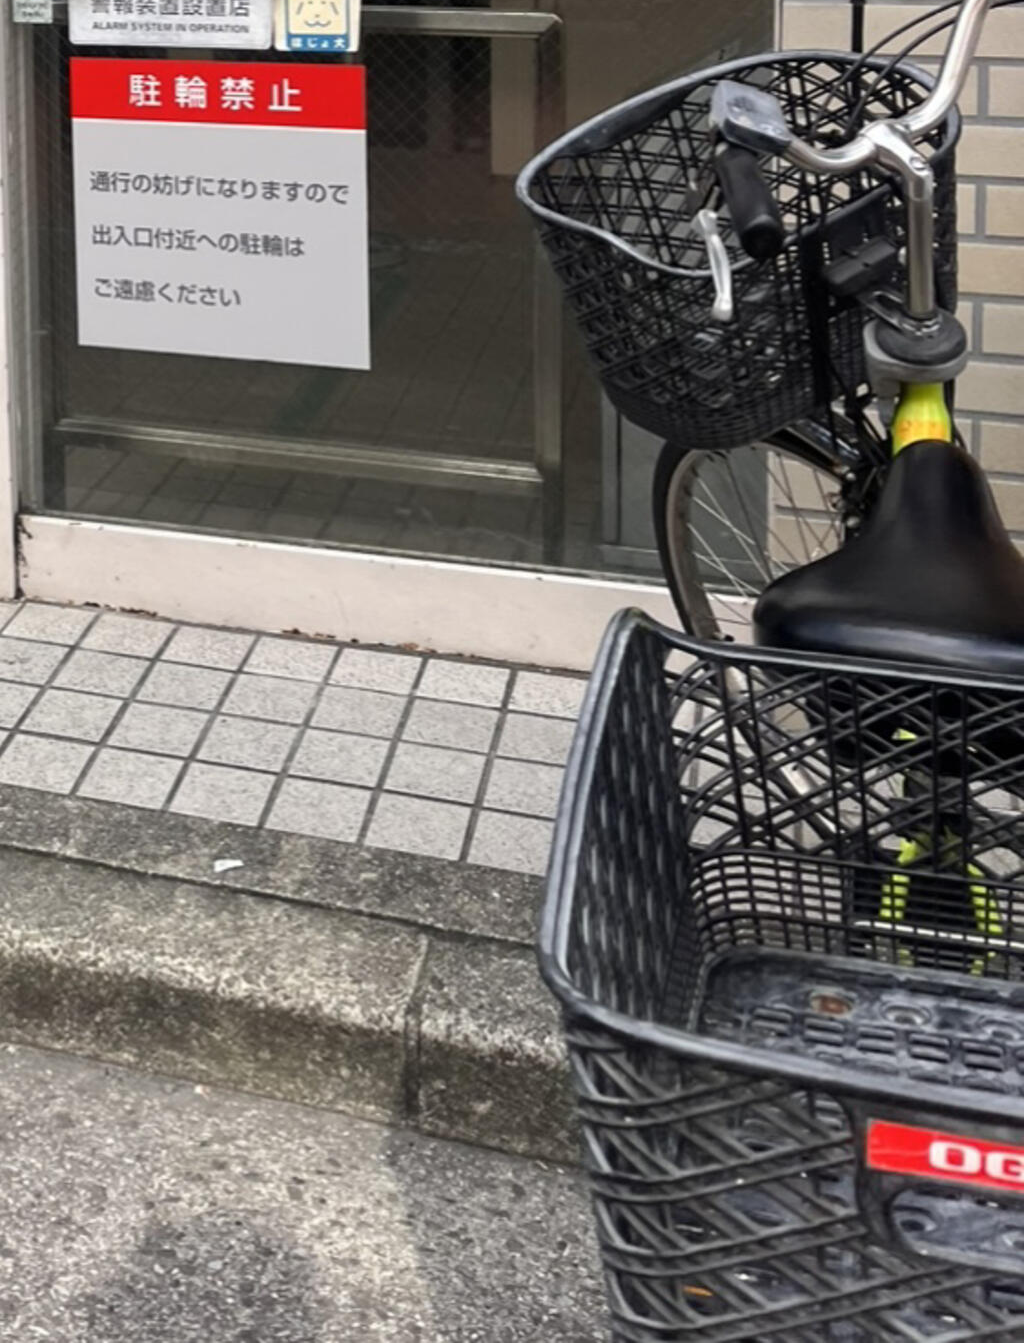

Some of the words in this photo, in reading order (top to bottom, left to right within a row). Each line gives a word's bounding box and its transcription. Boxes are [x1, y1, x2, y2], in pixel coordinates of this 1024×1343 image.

[92, 21, 128, 30] ALARM
[131, 22, 172, 32] SYSTEM
[175, 23, 186, 32] IN
[188, 23, 249, 33] OPERATION
[129, 74, 302, 112] 駐輪禁止
[90, 170, 349, 205] 通行の妨げになりますので
[92, 224, 304, 257] 出入口付近への駐輪は
[94, 278, 241, 307] ご遠慮ください
